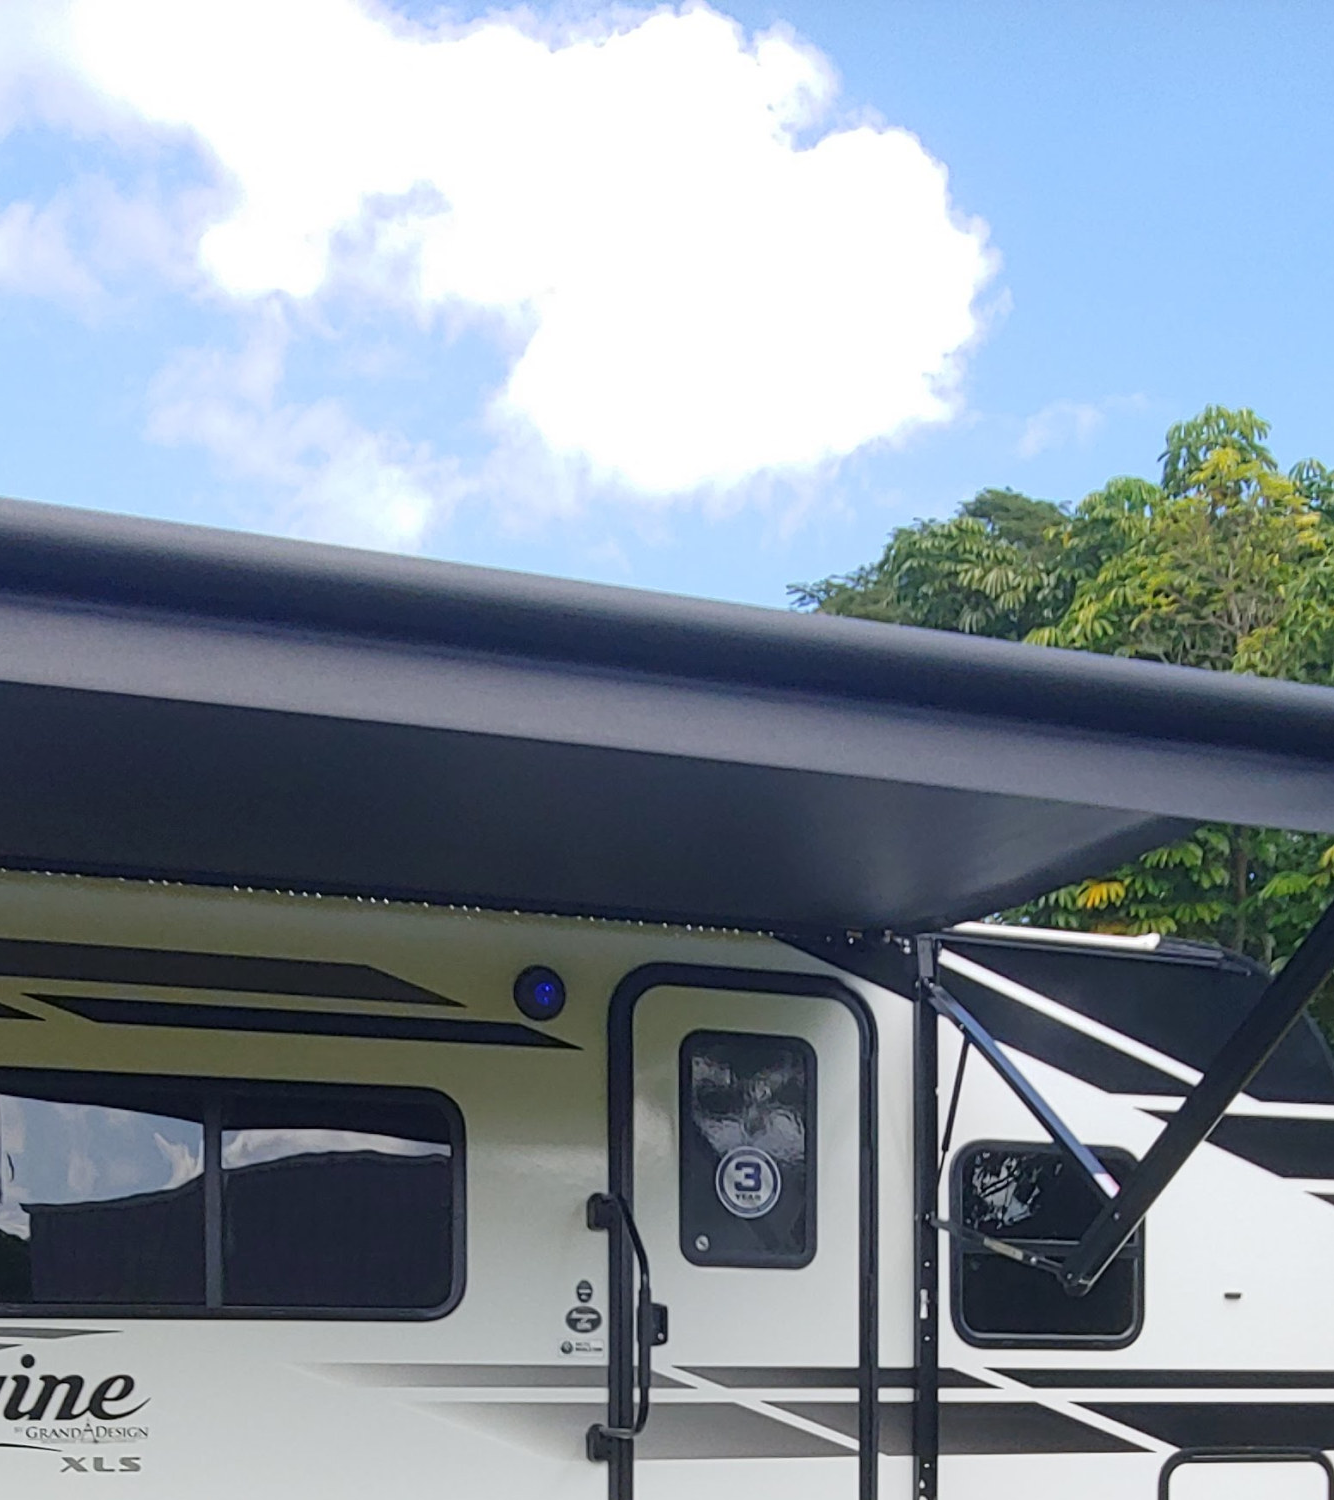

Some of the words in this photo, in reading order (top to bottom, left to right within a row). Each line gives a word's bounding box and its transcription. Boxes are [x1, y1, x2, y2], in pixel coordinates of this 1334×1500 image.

[735, 1162, 762, 1191] 3
[25, 1426, 82, 1439] GRAND
[95, 1425, 149, 1439] DESIGN
[60, 1456, 142, 1473] XLS
